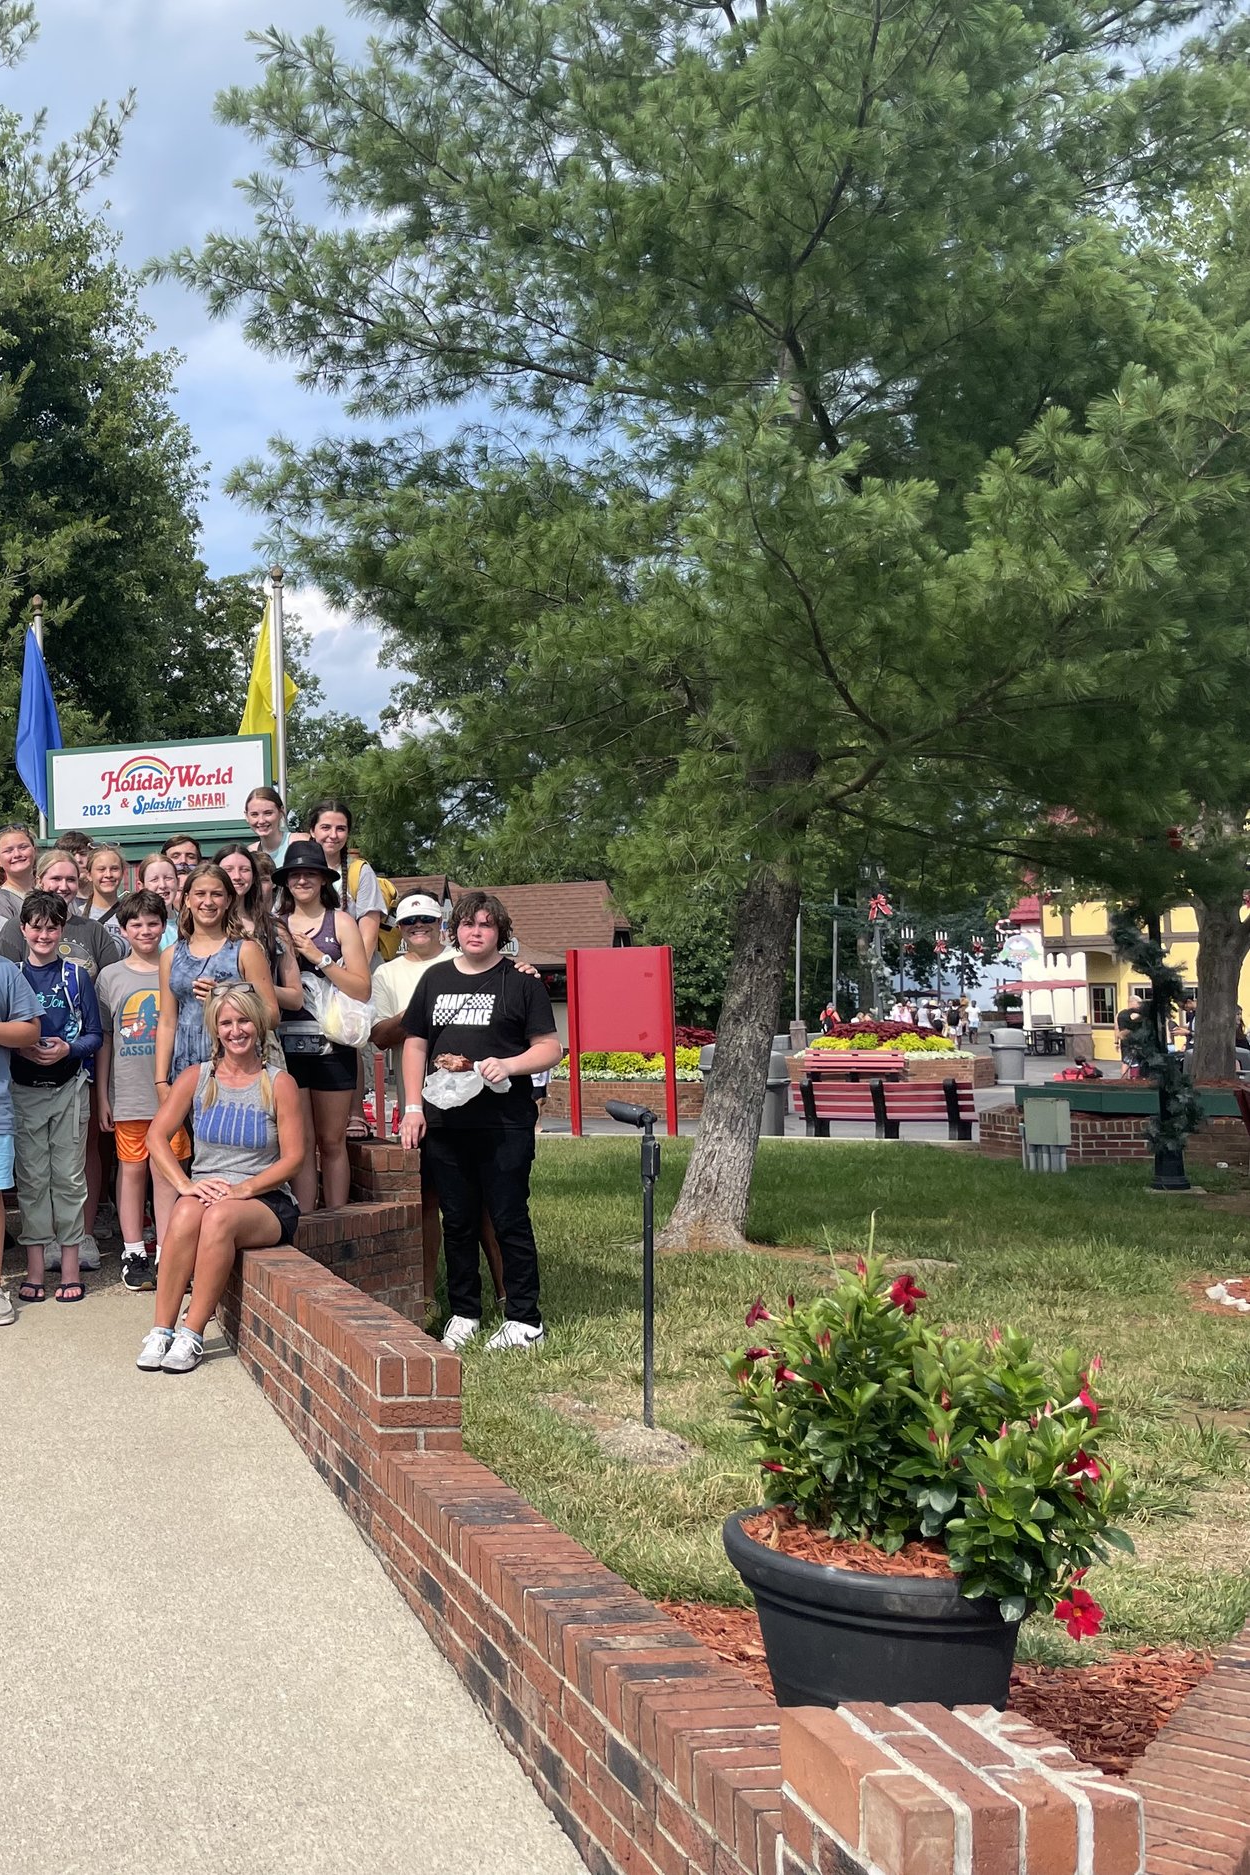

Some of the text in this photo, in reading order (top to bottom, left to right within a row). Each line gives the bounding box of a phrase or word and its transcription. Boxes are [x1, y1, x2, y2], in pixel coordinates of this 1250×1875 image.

[101, 764, 233, 800] Holiday World
[82, 804, 111, 817] 2023
[120, 792, 226, 815] & Splashin' SAFARI
[457, 1009, 492, 1026] BAKE
